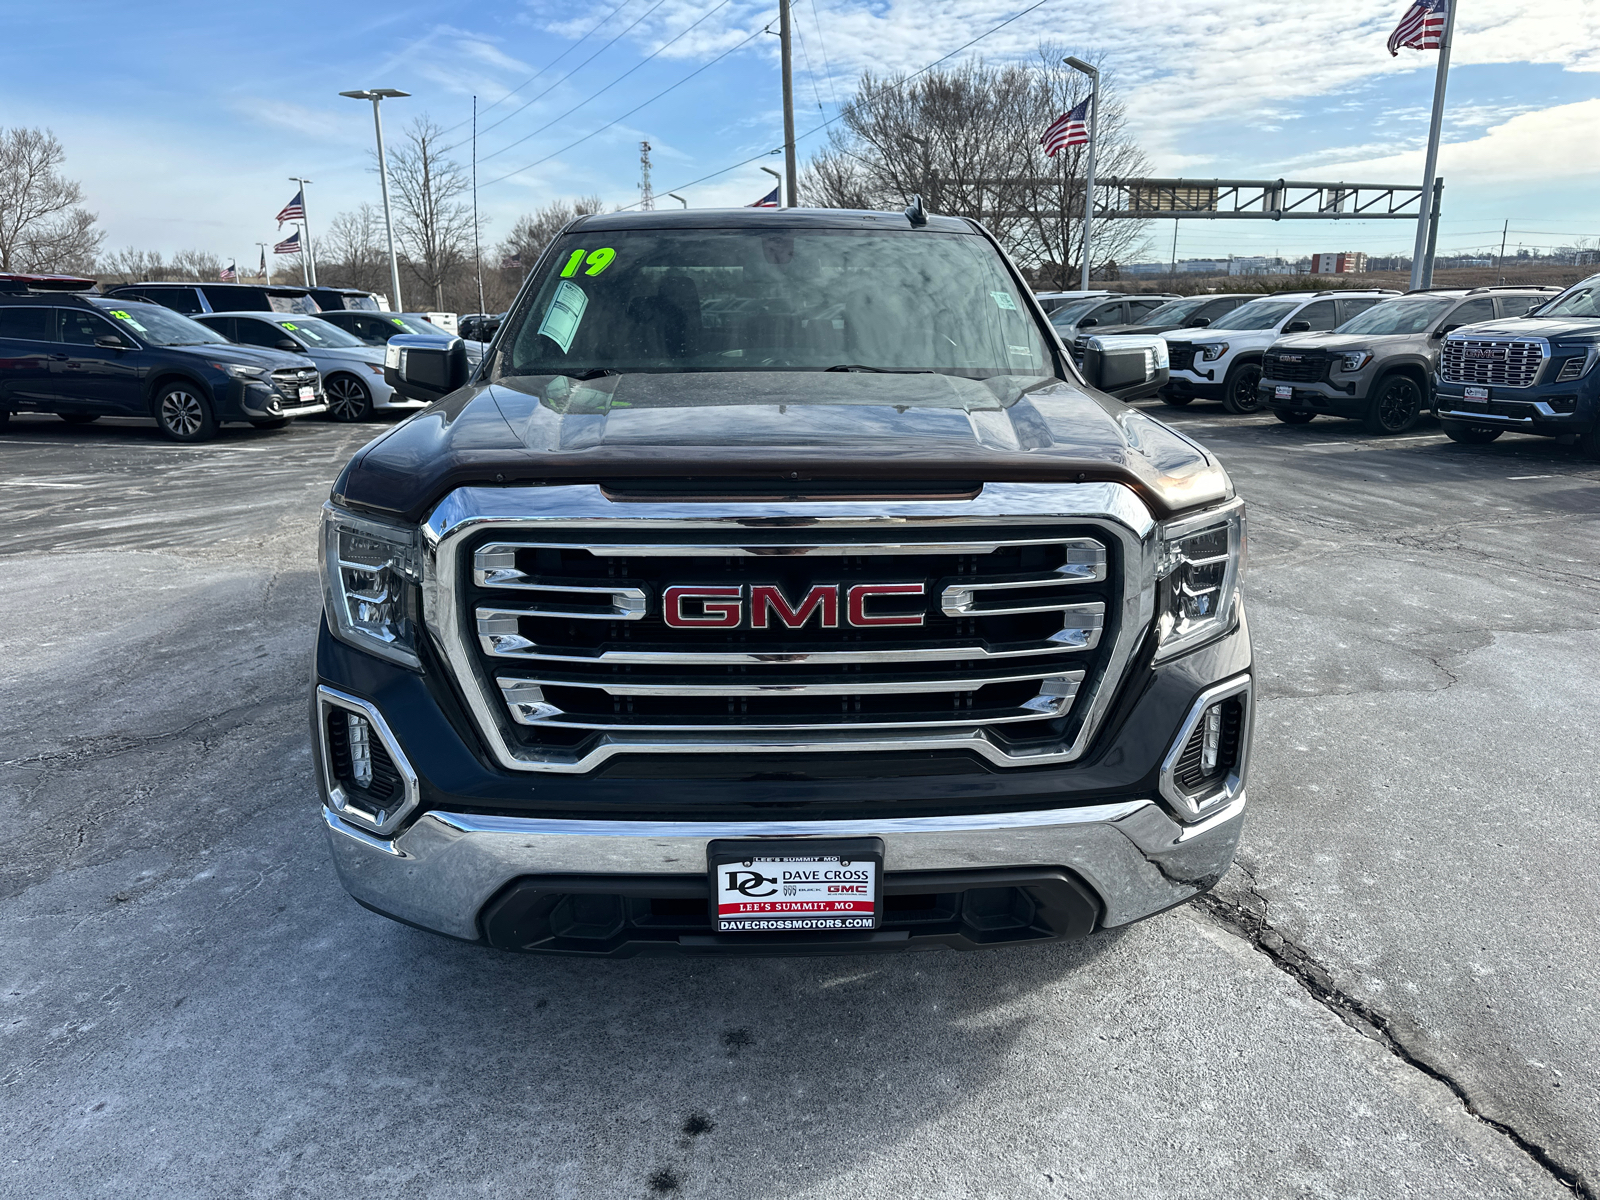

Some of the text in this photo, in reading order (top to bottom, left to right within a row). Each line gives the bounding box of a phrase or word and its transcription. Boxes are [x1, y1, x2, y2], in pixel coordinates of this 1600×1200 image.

[560, 247, 617, 278] 19
[661, 583, 927, 629] GMC
[782, 870, 869, 881] DAVE CROSS
[827, 885, 868, 893] GMC
[739, 902, 772, 912] LEE'S
[834, 902, 854, 910] MO
[720, 919, 872, 930] DAVECROSSMOTORS.COM
